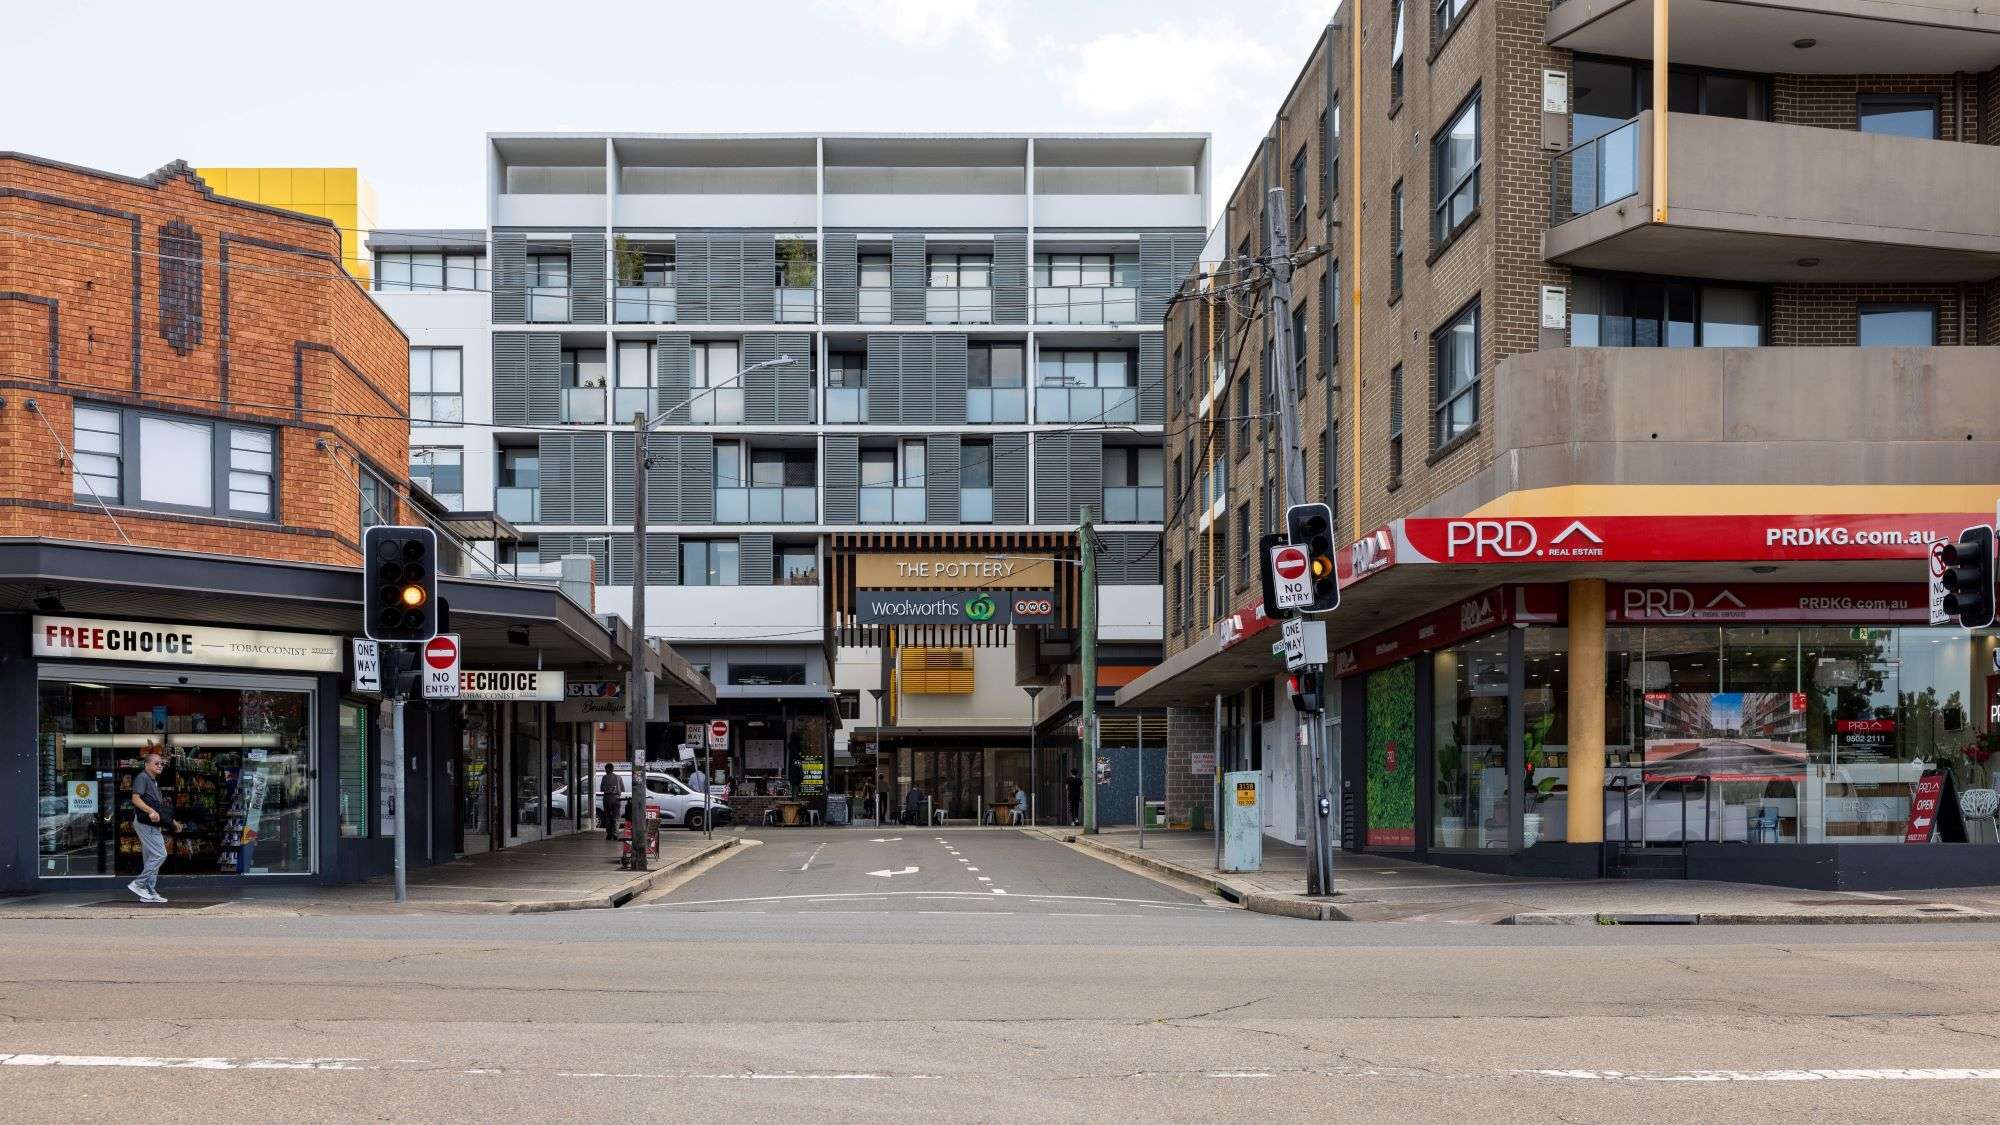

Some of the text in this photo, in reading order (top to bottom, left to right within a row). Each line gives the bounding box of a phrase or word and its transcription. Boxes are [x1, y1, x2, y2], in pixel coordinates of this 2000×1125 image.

[1766, 528, 1936, 546] PRDKG.com.au
[896, 562, 1015, 577] THE POTTERY
[1285, 582, 1302, 593] NO
[1280, 593, 1309, 603] ENTRY
[1800, 597, 1908, 609] PRDKG.com.au
[1932, 597, 1944, 607] LEF
[871, 600, 960, 615] Woolworths
[1018, 602, 1049, 611] BWS
[1285, 623, 1300, 637] ONE
[46, 626, 308, 656] FREECHOICE TOBACCONIST
[1285, 637, 1302, 652] WAY
[357, 643, 375, 656] ONE
[357, 660, 376, 672] WAY
[432, 672, 450, 682] NO
[460, 672, 537, 691] EECHOICE
[425, 685, 456, 693] ENTRY
[1916, 800, 1935, 811] OPEN
